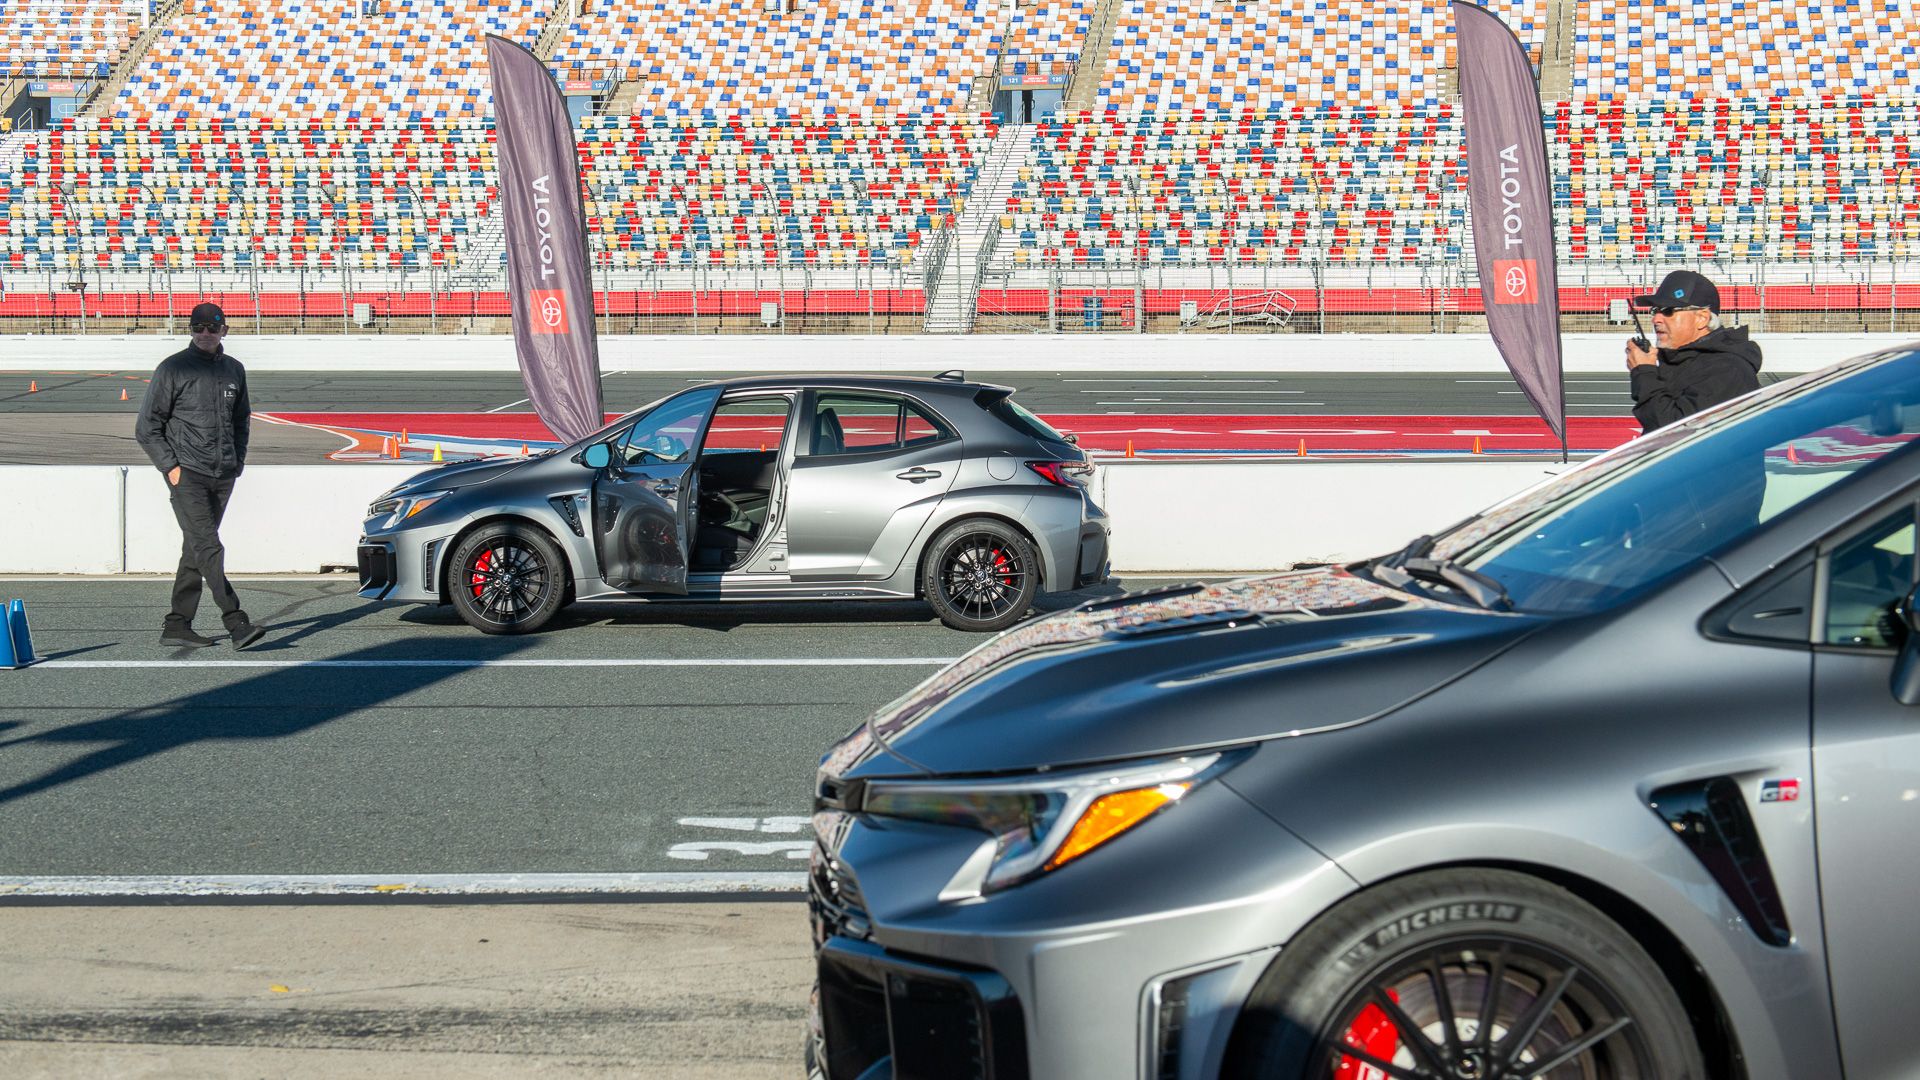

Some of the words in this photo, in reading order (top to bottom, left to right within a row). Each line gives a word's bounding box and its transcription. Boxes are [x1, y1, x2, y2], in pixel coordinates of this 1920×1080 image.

[532, 174, 556, 281] TOYOTA
[1500, 143, 1523, 250] TOYOTA
[1761, 787, 1799, 801] GR
[1377, 903, 1517, 946] MICHELIN
